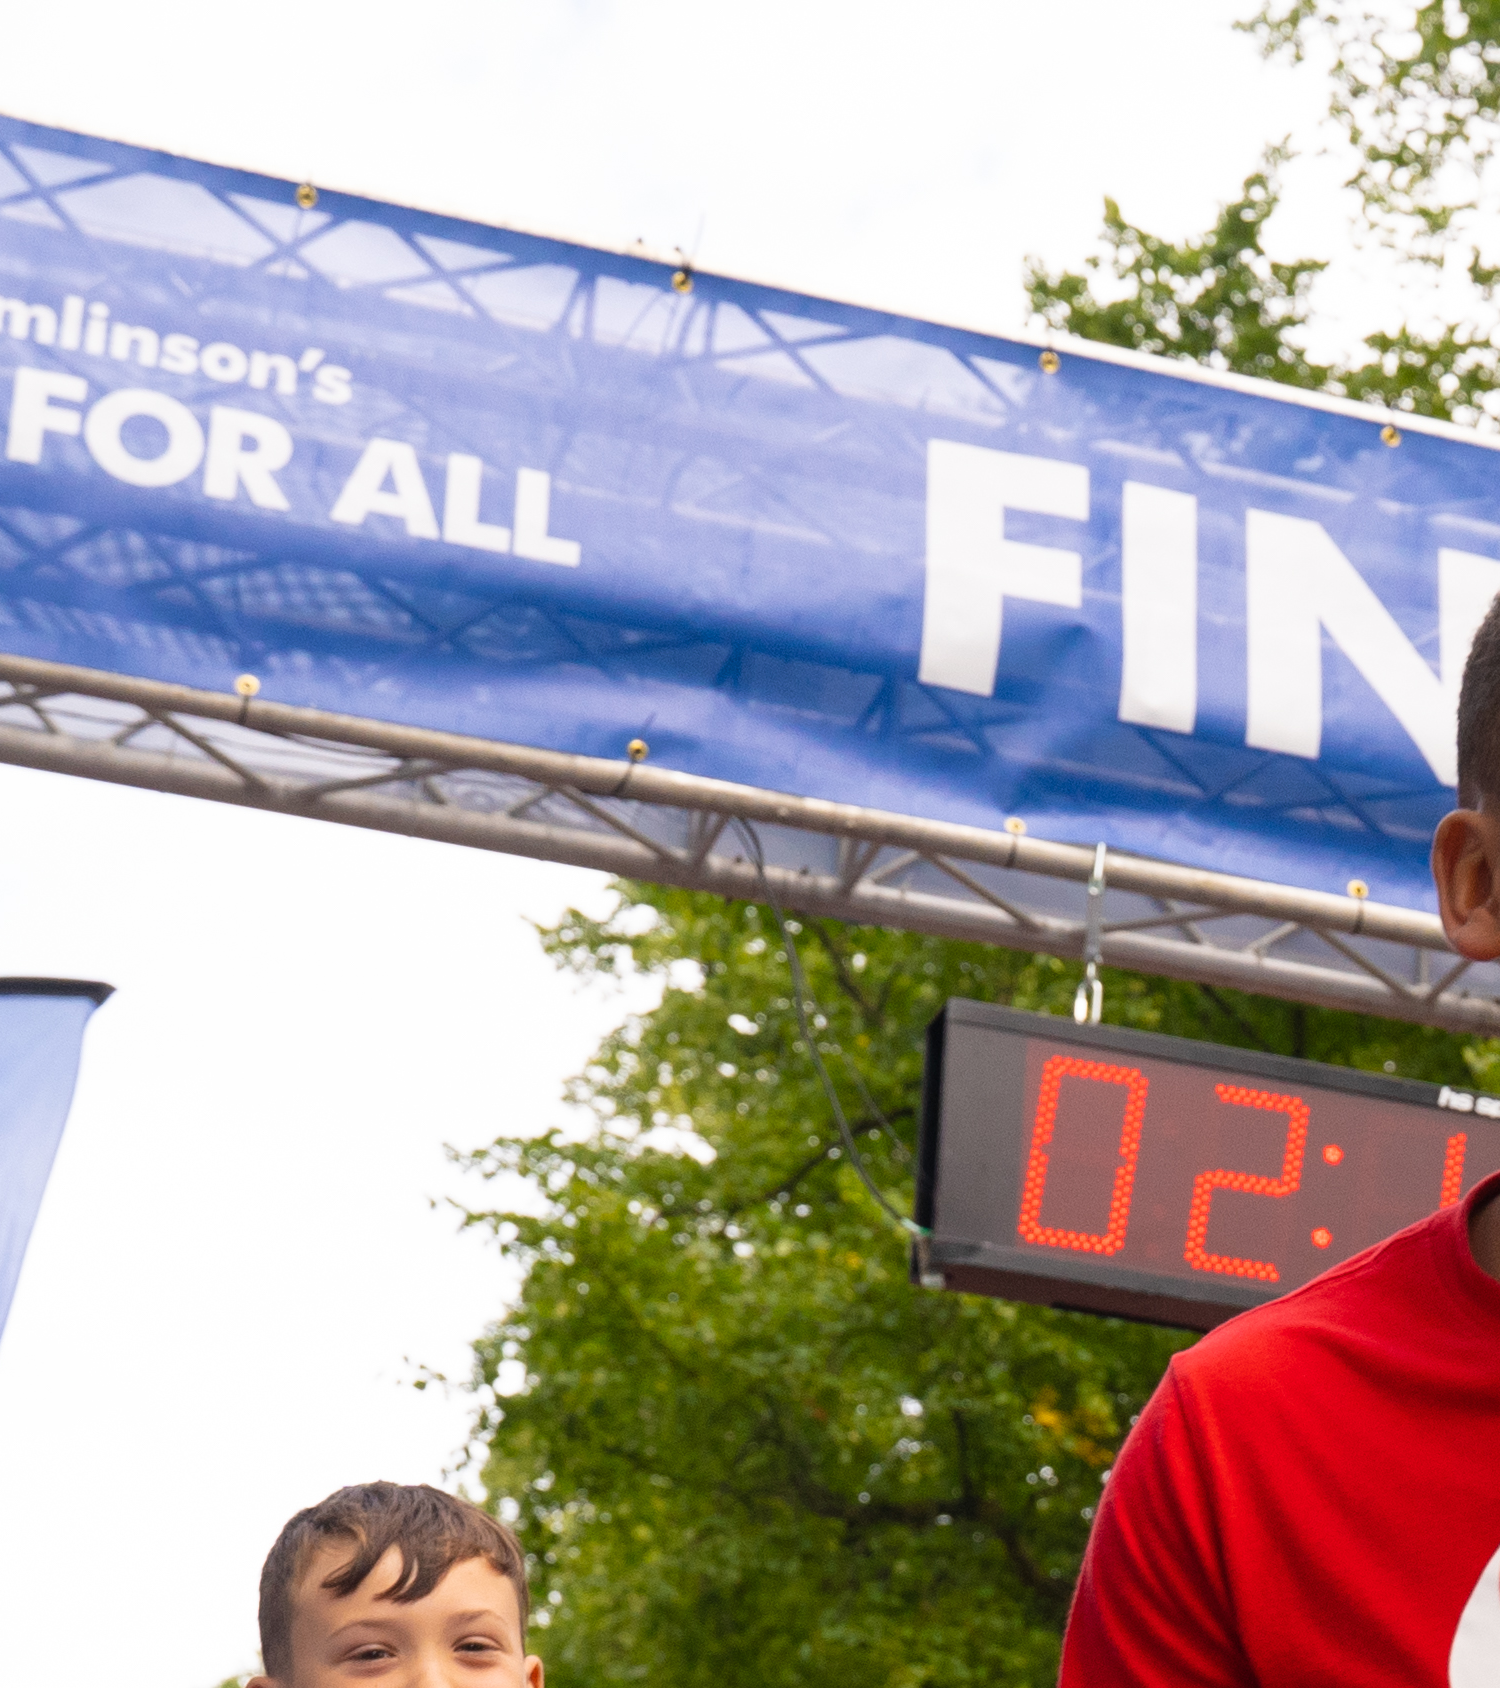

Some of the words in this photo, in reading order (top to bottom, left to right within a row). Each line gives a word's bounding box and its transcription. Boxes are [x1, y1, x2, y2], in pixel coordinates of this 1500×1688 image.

[6, 366, 294, 512] FOR
[330, 437, 582, 568] ALL
[1437, 1085, 1475, 1112] hs
